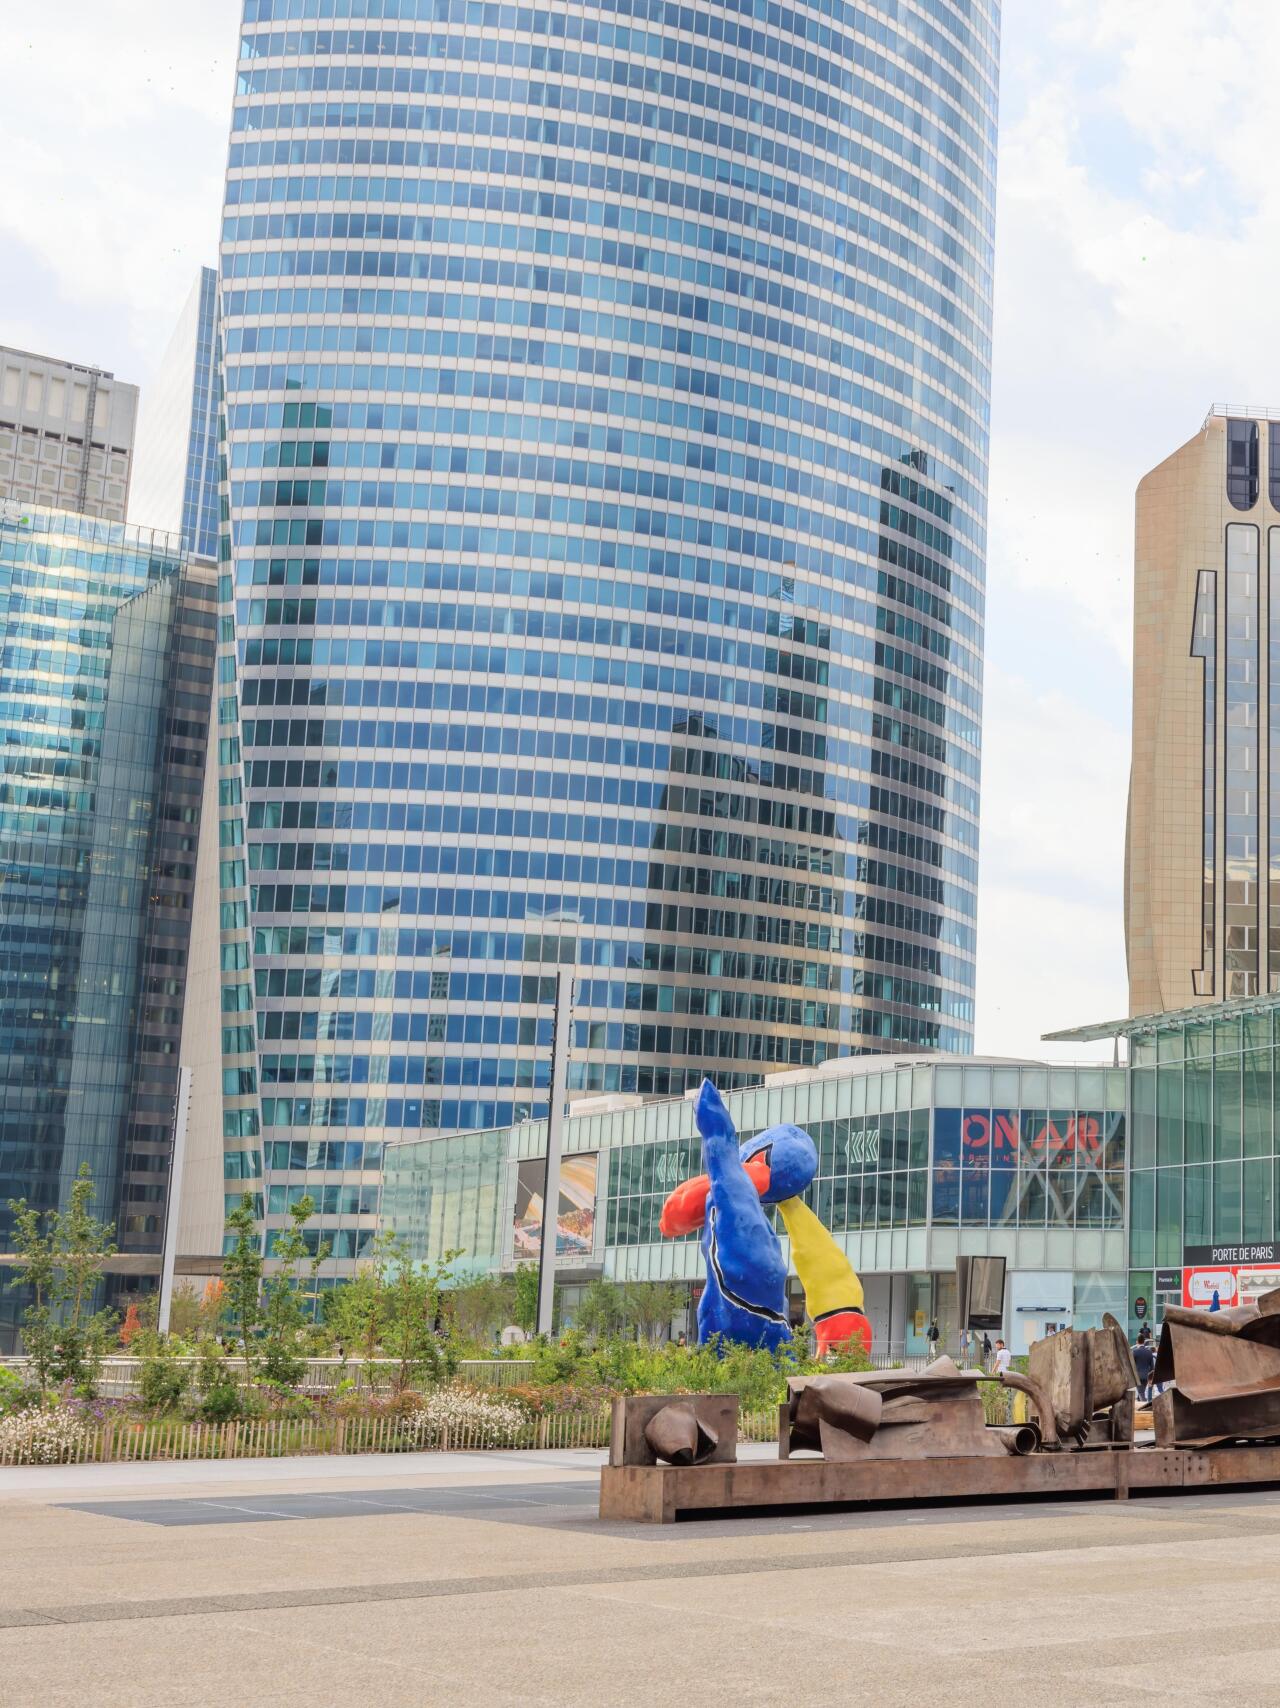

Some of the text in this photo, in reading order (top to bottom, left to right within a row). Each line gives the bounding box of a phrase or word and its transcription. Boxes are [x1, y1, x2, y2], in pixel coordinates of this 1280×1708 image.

[962, 1114, 1102, 1150] ON AIR
[1212, 1246, 1274, 1261] PORTE DE PARIS
